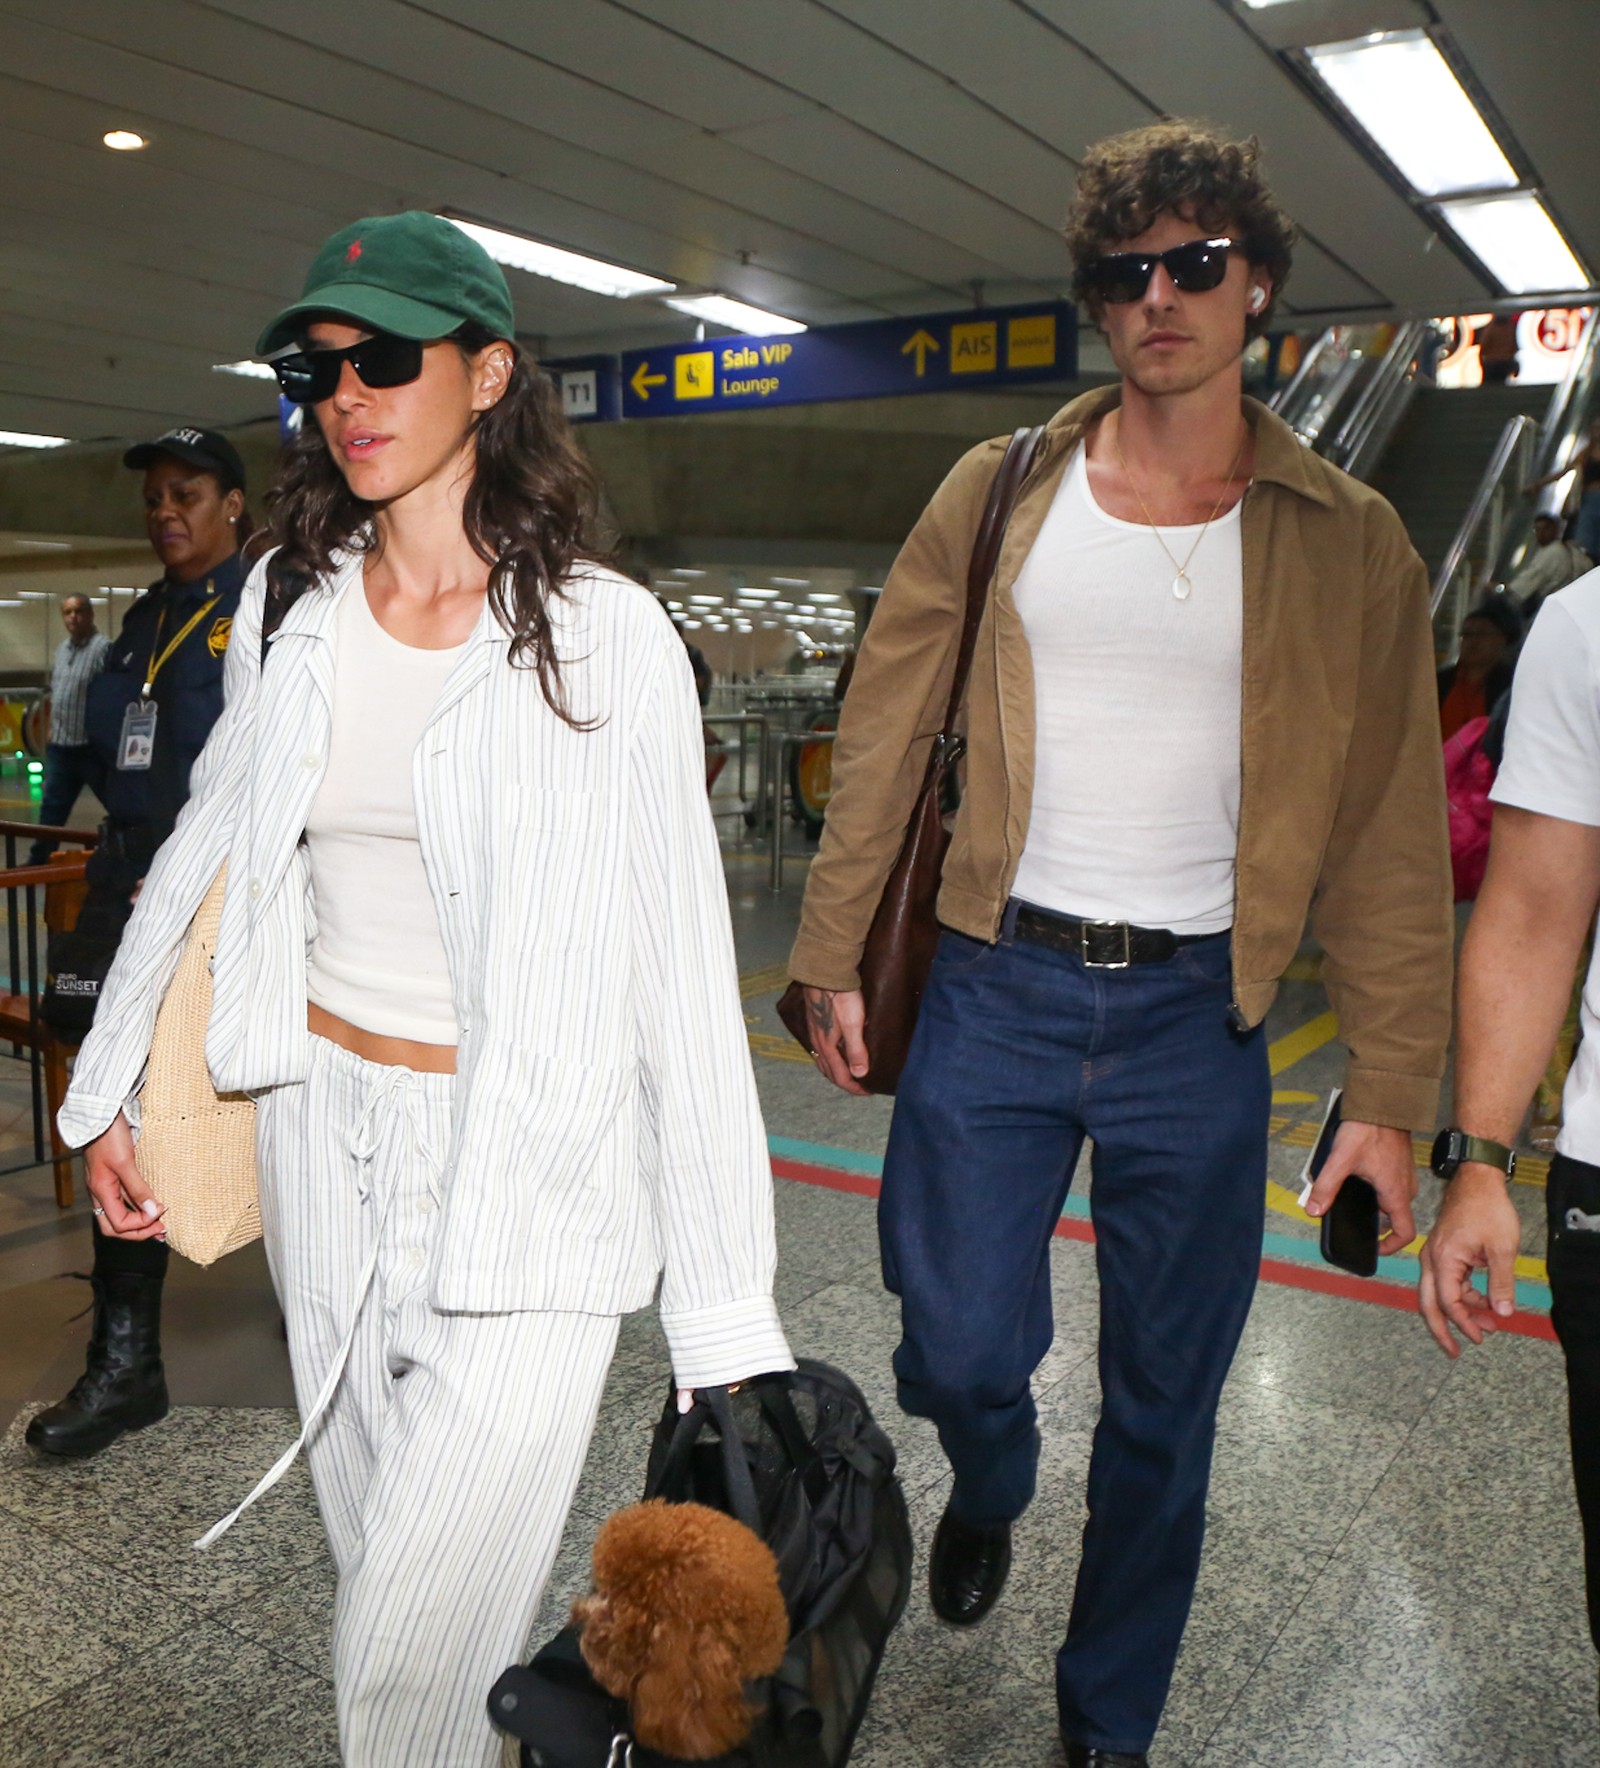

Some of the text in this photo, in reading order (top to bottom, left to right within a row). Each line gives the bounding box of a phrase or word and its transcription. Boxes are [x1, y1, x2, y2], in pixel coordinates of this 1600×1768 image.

[957, 335, 992, 356] AIS
[723, 343, 792, 370] Sala VIP
[568, 383, 590, 403] T1
[723, 377, 779, 397] Lounge
[56, 980, 99, 991] SUNSET
